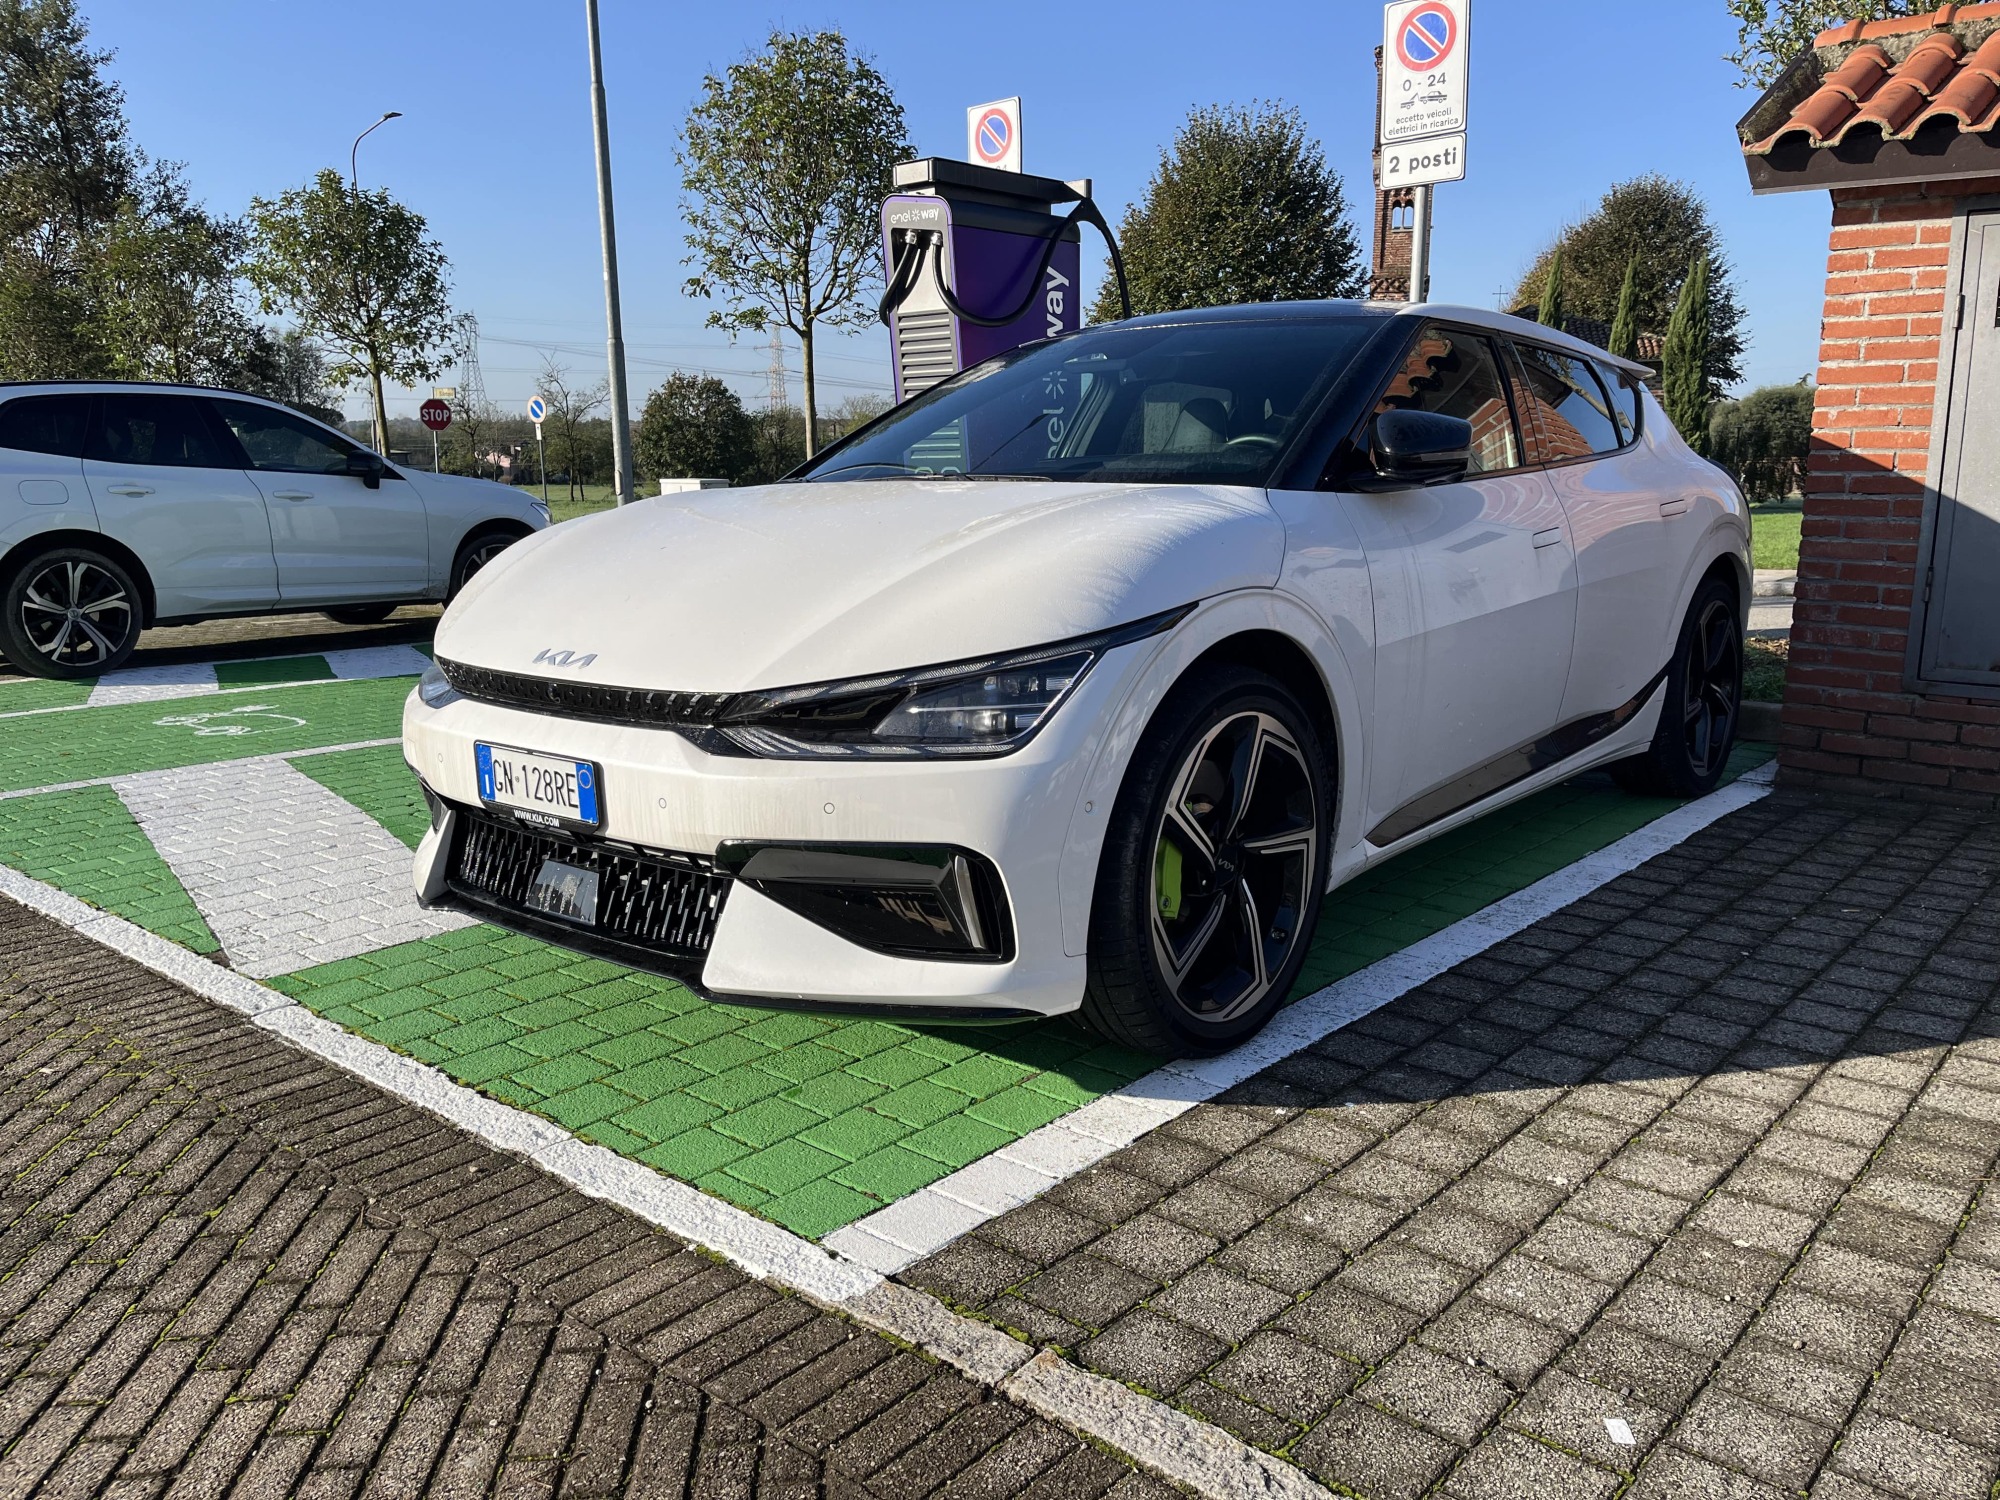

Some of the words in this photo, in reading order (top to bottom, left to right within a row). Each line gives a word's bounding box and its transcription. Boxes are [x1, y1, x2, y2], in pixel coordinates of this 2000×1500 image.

[1403, 79, 1412, 91] 0
[1427, 72, 1446, 87] 24
[1395, 113, 1424, 124] eccetto
[1427, 107, 1452, 119] veicoli
[1389, 123, 1418, 135] elettrici
[1420, 122, 1428, 130] in
[1429, 117, 1459, 128] ricarica
[1389, 156, 1400, 174] 2
[1409, 147, 1457, 174] posti
[890, 210, 911, 224] enel
[920, 208, 939, 221] way
[422, 408, 450, 421] STOP
[532, 648, 598, 669] KIA
[513, 809, 560, 828] WWW.KIA.COM
